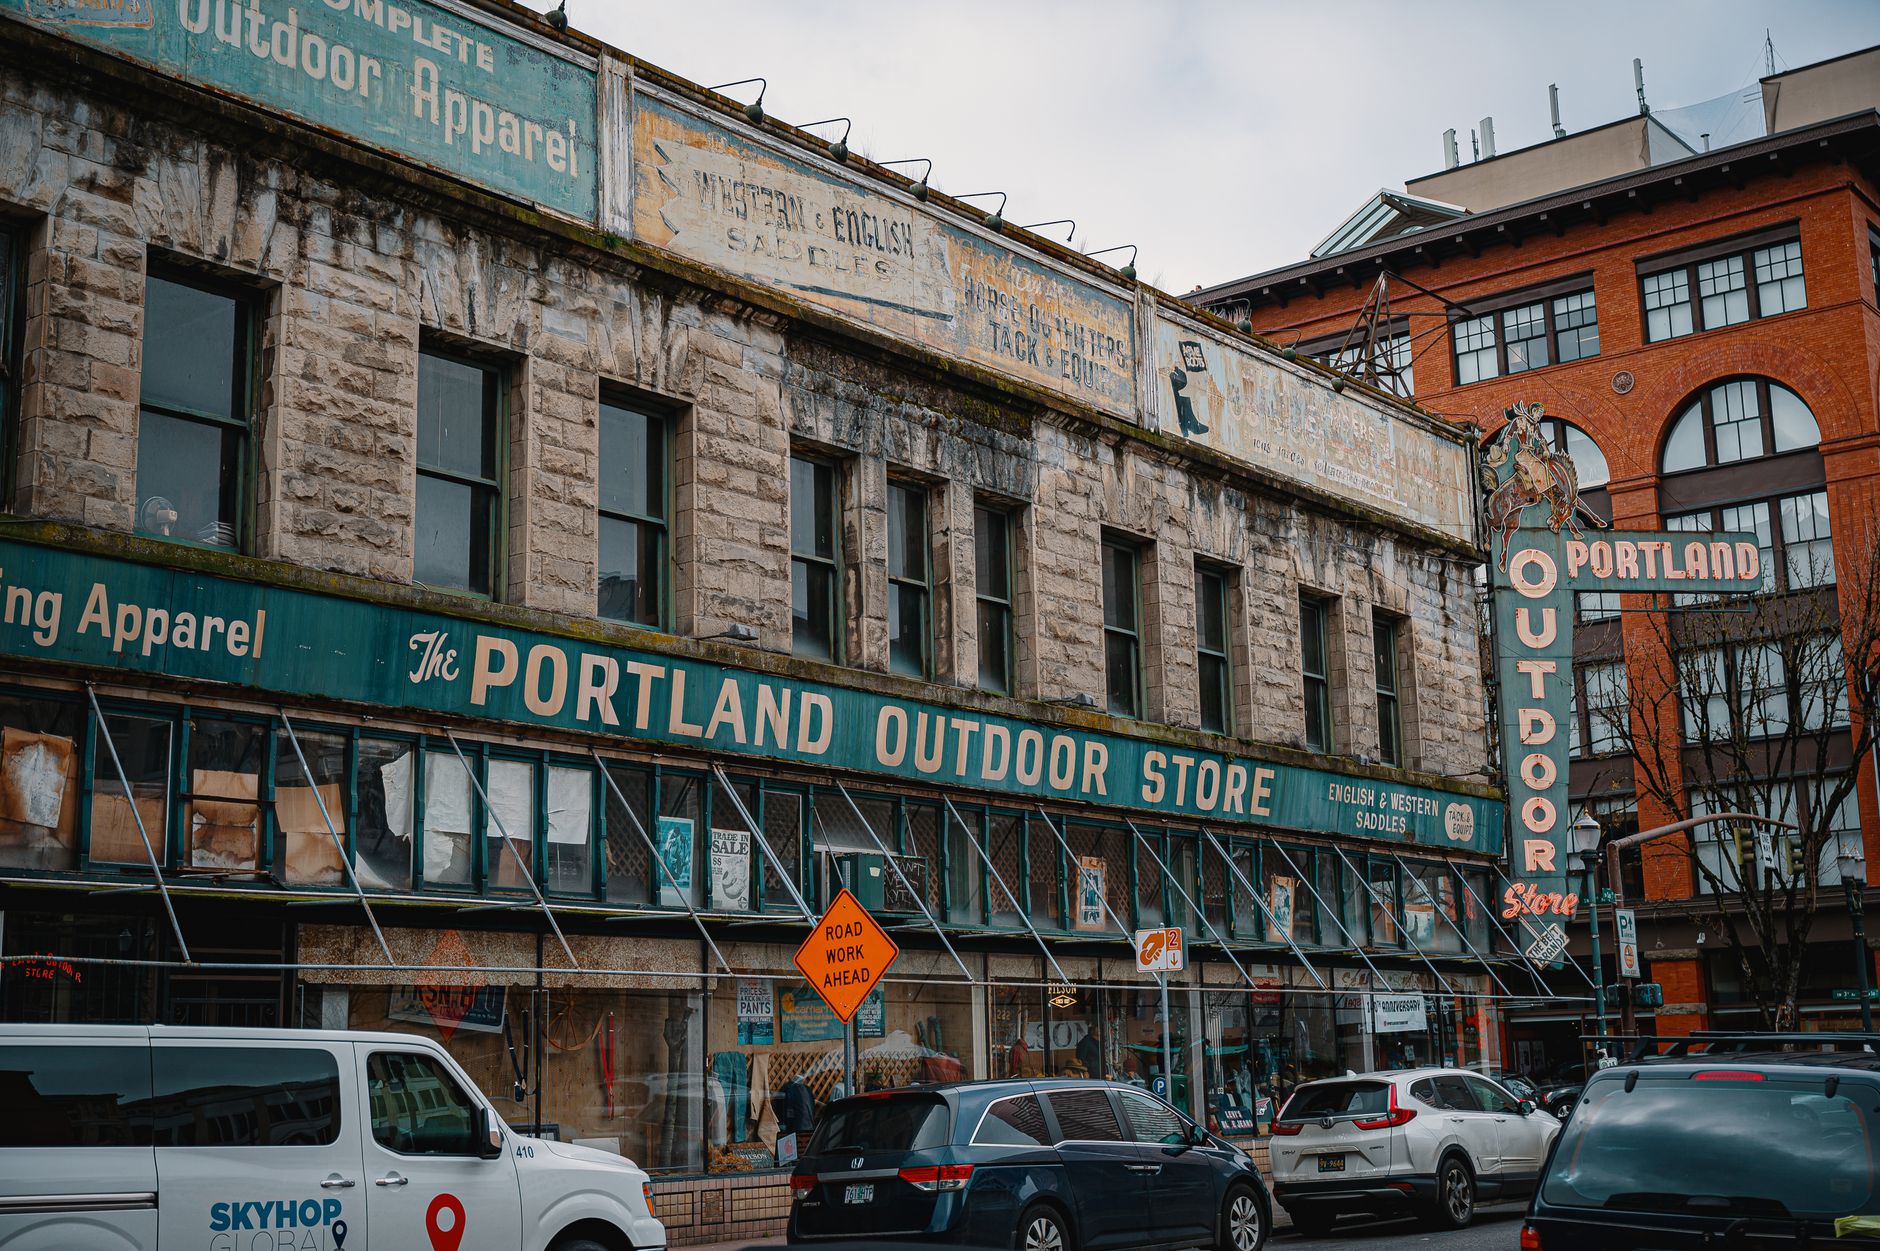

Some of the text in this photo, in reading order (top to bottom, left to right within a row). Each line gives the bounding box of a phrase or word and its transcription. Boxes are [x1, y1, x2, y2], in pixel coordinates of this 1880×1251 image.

[178, 0, 578, 177] Outdoor Apparel
[832, 205, 915, 260] ENGLISH
[989, 318, 1040, 368] TACK
[1566, 540, 1760, 580] PORTLAND
[0, 568, 266, 658] ng Apparel
[1508, 549, 1558, 873] OUTDOOR
[408, 631, 1276, 817] The PORTLAND OUTDOOR STORE
[1328, 783, 1440, 817] ENGLISH & WESTERN
[1355, 811, 1406, 834] SADDLES
[713, 831, 749, 843] TRADE IN
[712, 840, 749, 856] SALE
[1502, 882, 1579, 919] Store
[826, 922, 863, 941] ROAD
[1168, 930, 1178, 947] 2
[1541, 926, 1559, 946] BET
[826, 944, 865, 964] WORK
[25, 967, 55, 979] STORE
[823, 968, 870, 989] AHEAD
[740, 1002, 771, 1014] PANTS
[1157, 1081, 1165, 1092] P
[1225, 1110, 1243, 1119] LEVI'S
[516, 1146, 534, 1159] 410
[209, 1199, 342, 1231] SKYHOP
